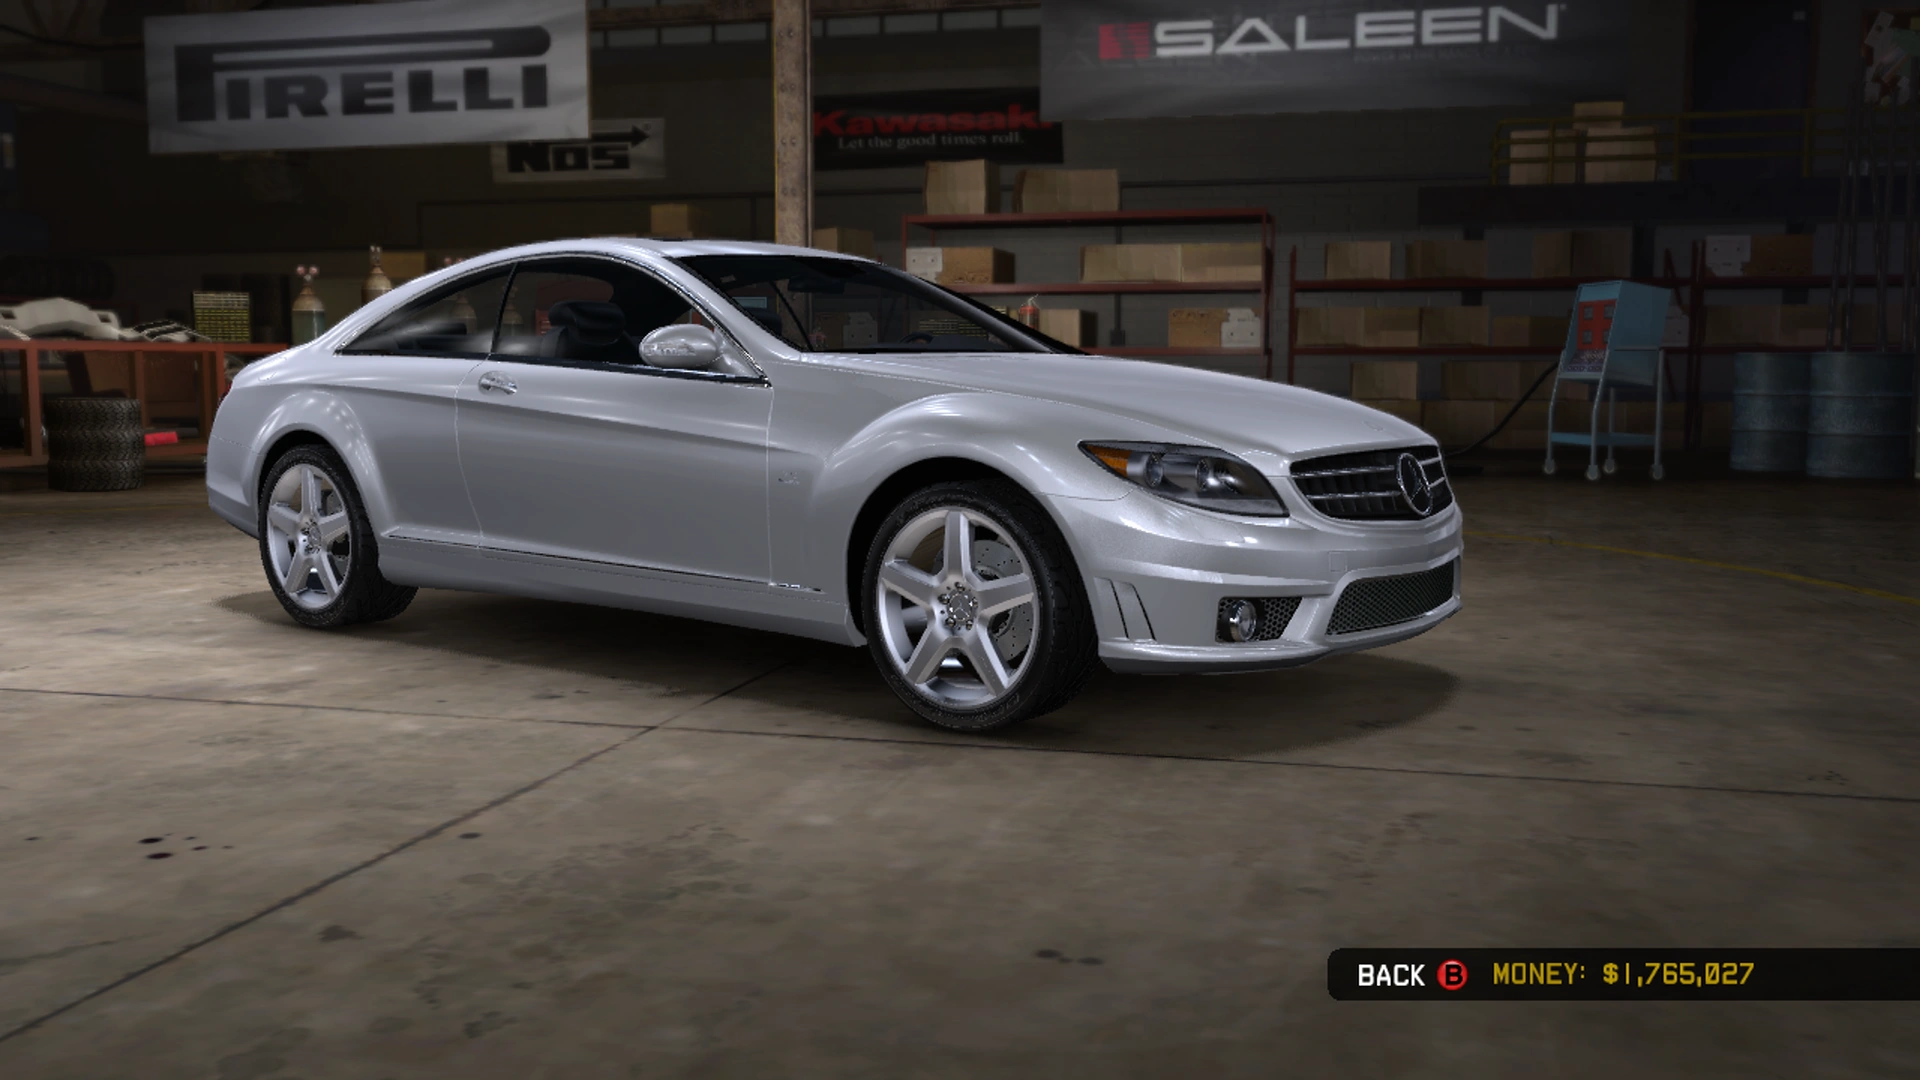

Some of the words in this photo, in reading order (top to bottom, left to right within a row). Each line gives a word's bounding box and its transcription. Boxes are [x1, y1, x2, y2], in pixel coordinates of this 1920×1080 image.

[1153, 3, 1559, 59] SALEEN
[174, 25, 551, 123] PIRELLI
[813, 103, 1054, 137] Kawasak
[506, 139, 631, 173] NOS
[838, 136, 865, 150] Let
[868, 134, 892, 148] the
[896, 132, 937, 150] good
[941, 132, 987, 146] times
[992, 131, 1025, 145] roll.
